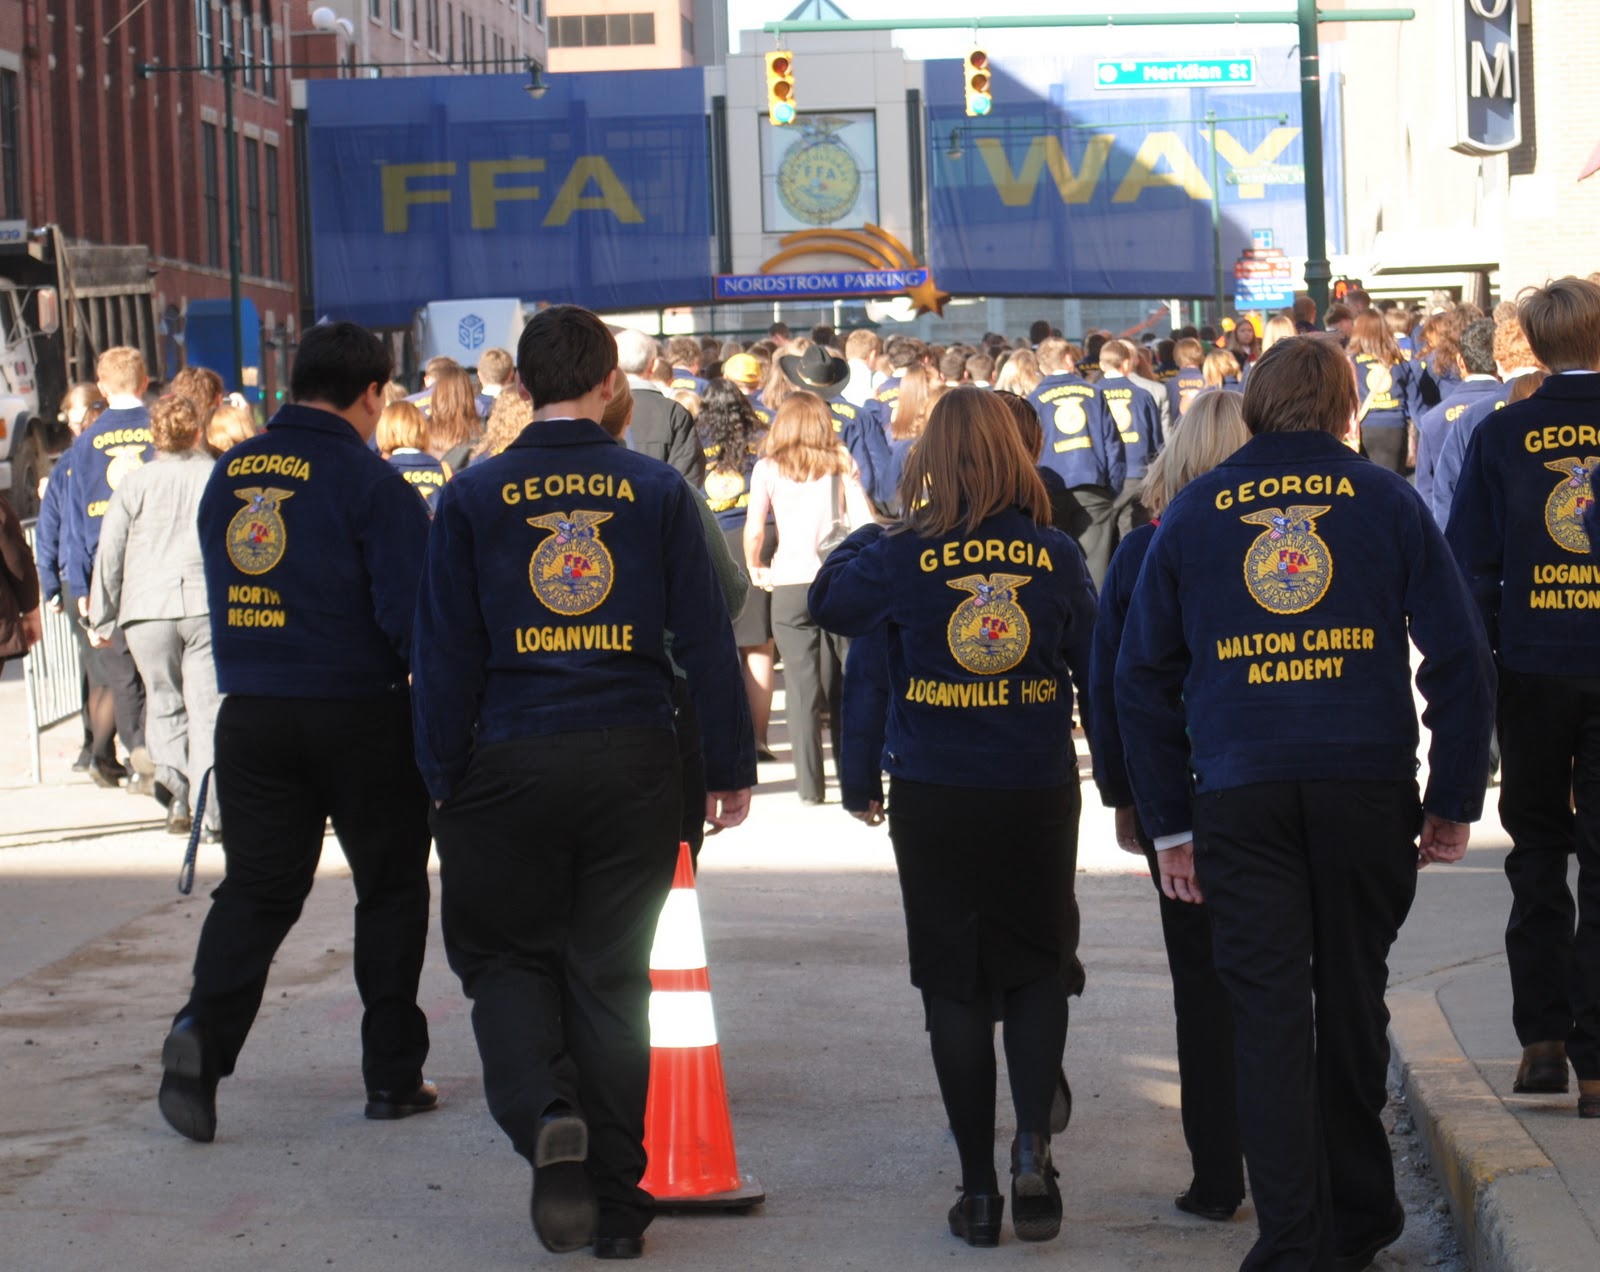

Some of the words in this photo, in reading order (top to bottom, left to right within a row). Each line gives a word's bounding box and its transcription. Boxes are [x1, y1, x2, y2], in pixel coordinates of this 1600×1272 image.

[1143, 62, 1221, 81] Meridian
[1229, 63, 1248, 80] St
[804, 167, 836, 180] FFA
[975, 128, 1301, 206] WAY
[381, 156, 645, 233] FFA
[725, 275, 837, 292] NORDSTROM
[844, 272, 919, 288] PARKING
[1179, 379, 1203, 388] OHIO
[93, 428, 154, 449] OREGON
[1525, 425, 1600, 453] GEOR
[227, 455, 310, 481] GEORGIA
[502, 474, 635, 505] GEORGIA
[1215, 475, 1355, 510] GEORGIA
[251, 523, 270, 538] FFA
[564, 554, 592, 570] FFA
[920, 539, 1053, 572] GEORGIA
[1261, 540, 1312, 564] AGRICULTURAL
[1279, 550, 1308, 566] FFA
[228, 585, 281, 604] NORTH
[1530, 590, 1600, 609] WALTON
[228, 609, 285, 627] REGION
[982, 616, 1008, 632] FFA
[516, 624, 633, 653] LOGANVILLE
[1217, 632, 1296, 660] WALTON
[1303, 628, 1375, 651] CAREER
[1248, 657, 1344, 684] ACADEMY
[906, 677, 1009, 707] LOGANVILLE
[1022, 679, 1057, 704] HIGH
